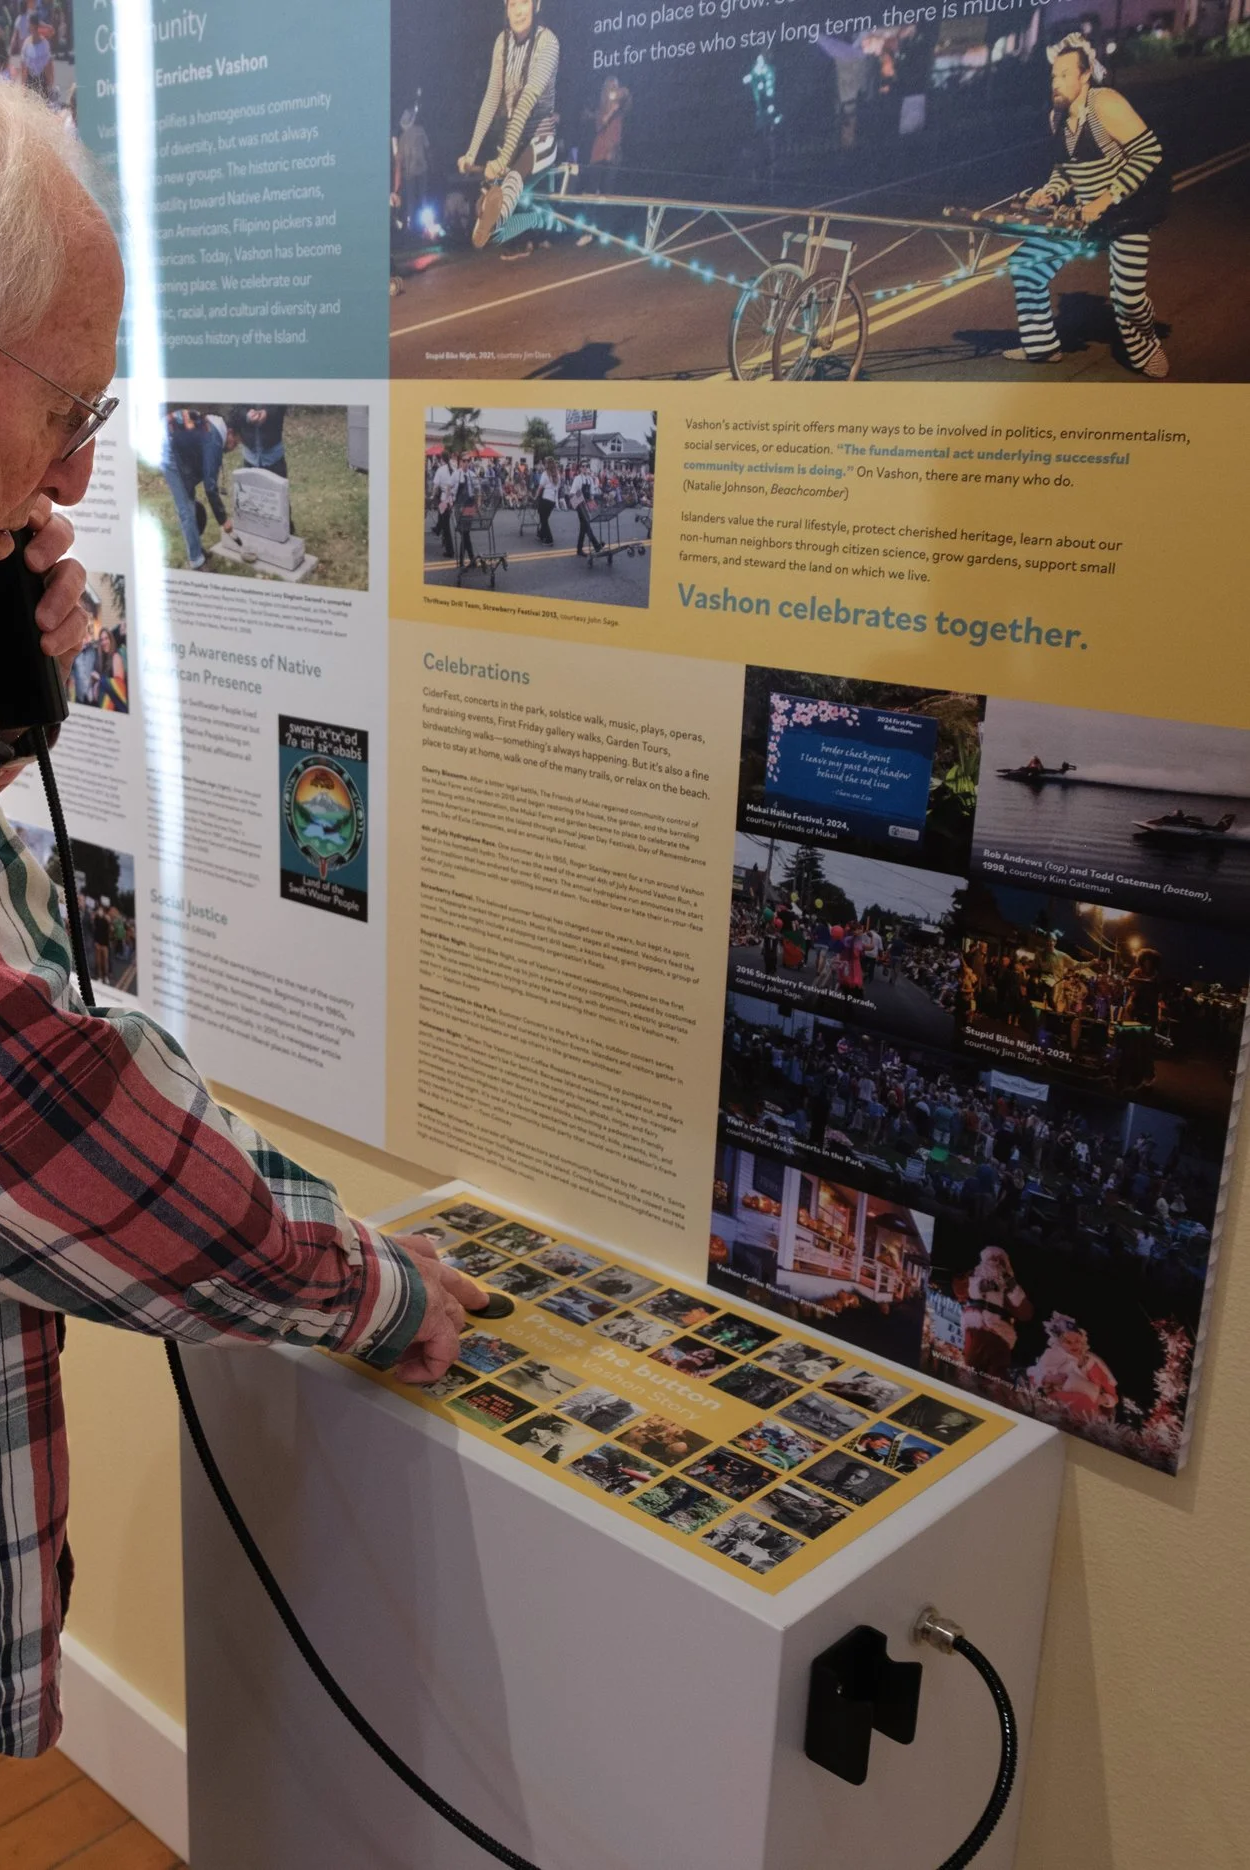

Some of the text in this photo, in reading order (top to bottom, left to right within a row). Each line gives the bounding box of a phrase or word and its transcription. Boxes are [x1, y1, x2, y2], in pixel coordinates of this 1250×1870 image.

[593, 12, 622, 33] and
[627, 13, 646, 28] no
[650, 5, 694, 29] place
[698, 0, 716, 16] to
[593, 50, 620, 68] But
[623, 45, 647, 64] for
[650, 41, 696, 60] those
[699, 32, 736, 53] who
[740, 29, 776, 49] stay
[780, 23, 823, 43] long
[825, 16, 880, 37] term,
[879, 6, 936, 34] there
[942, 3, 957, 18] is
[155, 55, 268, 87] Enriches Vashon
[685, 418, 1190, 445] Vashon's activist spirit offers many ways to be involved in politics, environmentalism,
[684, 440, 712, 450] social
[714, 441, 759, 453] services,
[761, 444, 774, 452] or
[775, 442, 833, 454] education.
[868, 444, 950, 458] fundamental
[952, 449, 974, 459] act
[977, 448, 1052, 465] underlying
[1055, 452, 1130, 464] successful
[683, 461, 745, 475] community
[747, 462, 794, 474] activism
[797, 464, 807, 474] is
[856, 466, 873, 477] On
[876, 467, 922, 481] Vashon,
[925, 469, 958, 481] there
[961, 473, 981, 482] are
[984, 475, 1020, 487] many
[1022, 473, 1050, 485] who
[1053, 474, 1073, 486] do.
[683, 479, 849, 501] (Natalie Johnson, Beachcomber)
[681, 511, 1123, 550] Islanders value the rural lifestyle, protect cherished heritage, learn about our
[679, 550, 930, 582] farmers, and steward the land on which we live.
[740, 537, 792, 550] neighbors
[795, 540, 839, 555] through
[841, 544, 879, 555] citizen
[882, 547, 929, 561] science,
[932, 552, 964, 564] grow
[966, 554, 1021, 569] gardens,
[1025, 559, 1077, 572] support
[1079, 562, 1116, 574] small
[678, 583, 1087, 649] Vashon celebrates together.
[188, 641, 321, 677] Awareness of Native
[423, 652, 530, 684] Celebrations
[203, 670, 262, 694] Presence
[422, 686, 462, 703] CiderFest,
[463, 696, 499, 707] concerts
[510, 702, 524, 712] the
[525, 706, 547, 717] park,
[549, 709, 582, 721] solstice
[583, 715, 606, 727] walk,
[608, 720, 638, 733] music,
[640, 724, 667, 738] plays,
[669, 730, 705, 744] operas,
[422, 704, 670, 757] fundraising events, First Friday gallery walks, Garden Tours,
[745, 816, 777, 828] courtesy
[777, 820, 805, 832] Friends
[815, 828, 837, 839] Mukai
[746, 803, 849, 831] Mukai Haiku Festival, 2024,
[983, 848, 1212, 902] Rob Andrews (top) and Todd Gateman (bottom),
[187, 897, 228, 925] Justice
[736, 965, 876, 1009] 2016 Strawberry Festival Kids Parade,
[965, 1026, 1072, 1062] Stupid Bike Night, 2021,
[524, 1314, 722, 1411] Press the button
[582, 1358, 700, 1420] Vashon Story
